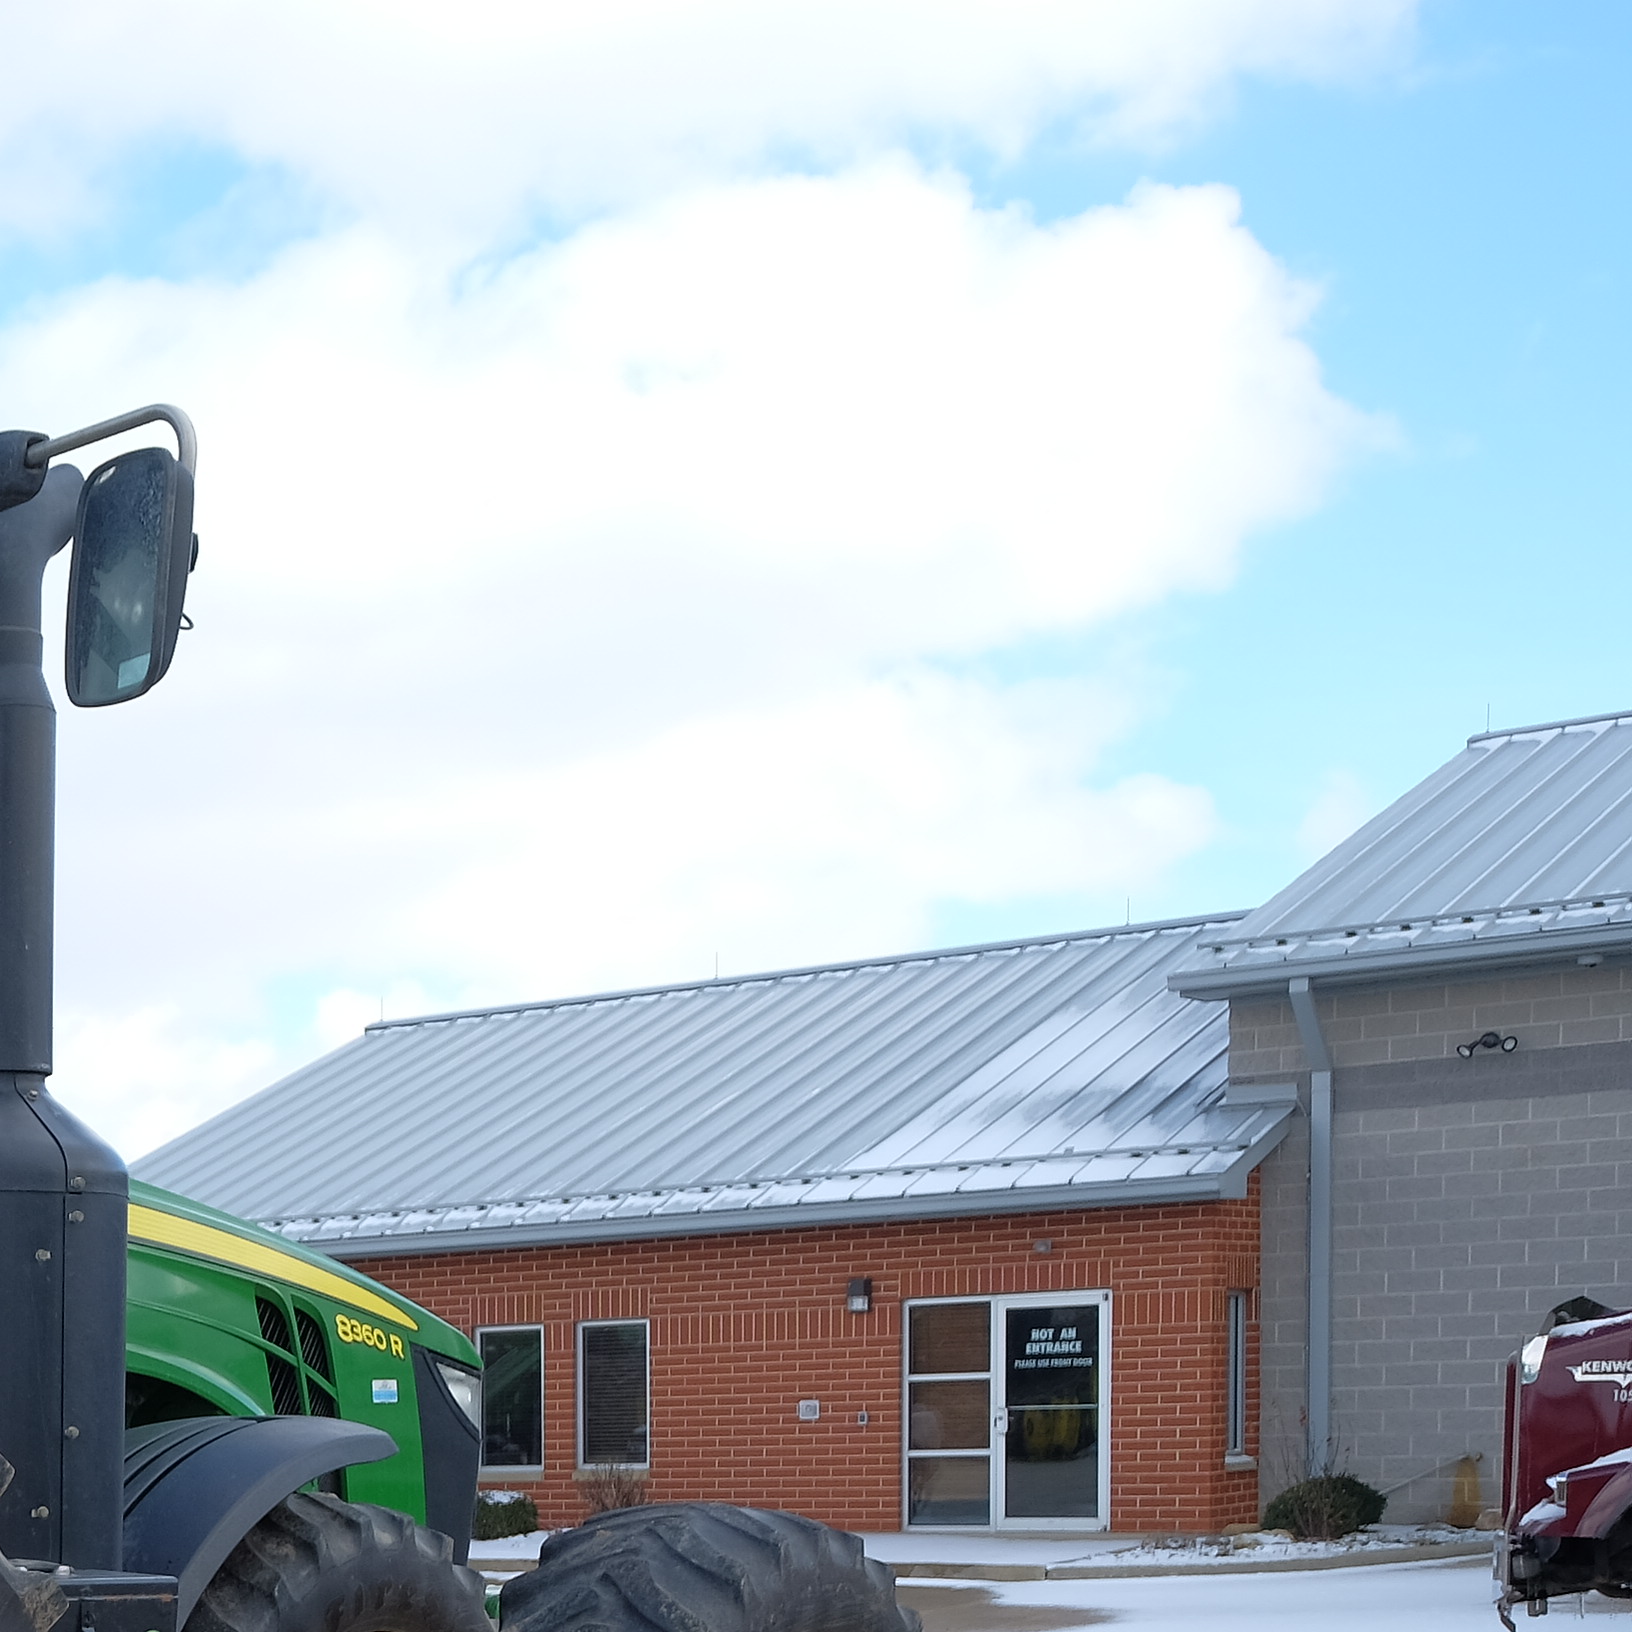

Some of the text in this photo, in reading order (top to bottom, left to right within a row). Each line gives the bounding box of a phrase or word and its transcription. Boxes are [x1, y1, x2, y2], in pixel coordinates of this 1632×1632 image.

[335, 1313, 405, 1360] 8360 R
[1031, 1327, 1077, 1341] NOT AN
[1025, 1341, 1083, 1355] ENTRANCE
[1014, 1359, 1037, 1369] PLEASE
[1073, 1357, 1093, 1367] DOOR
